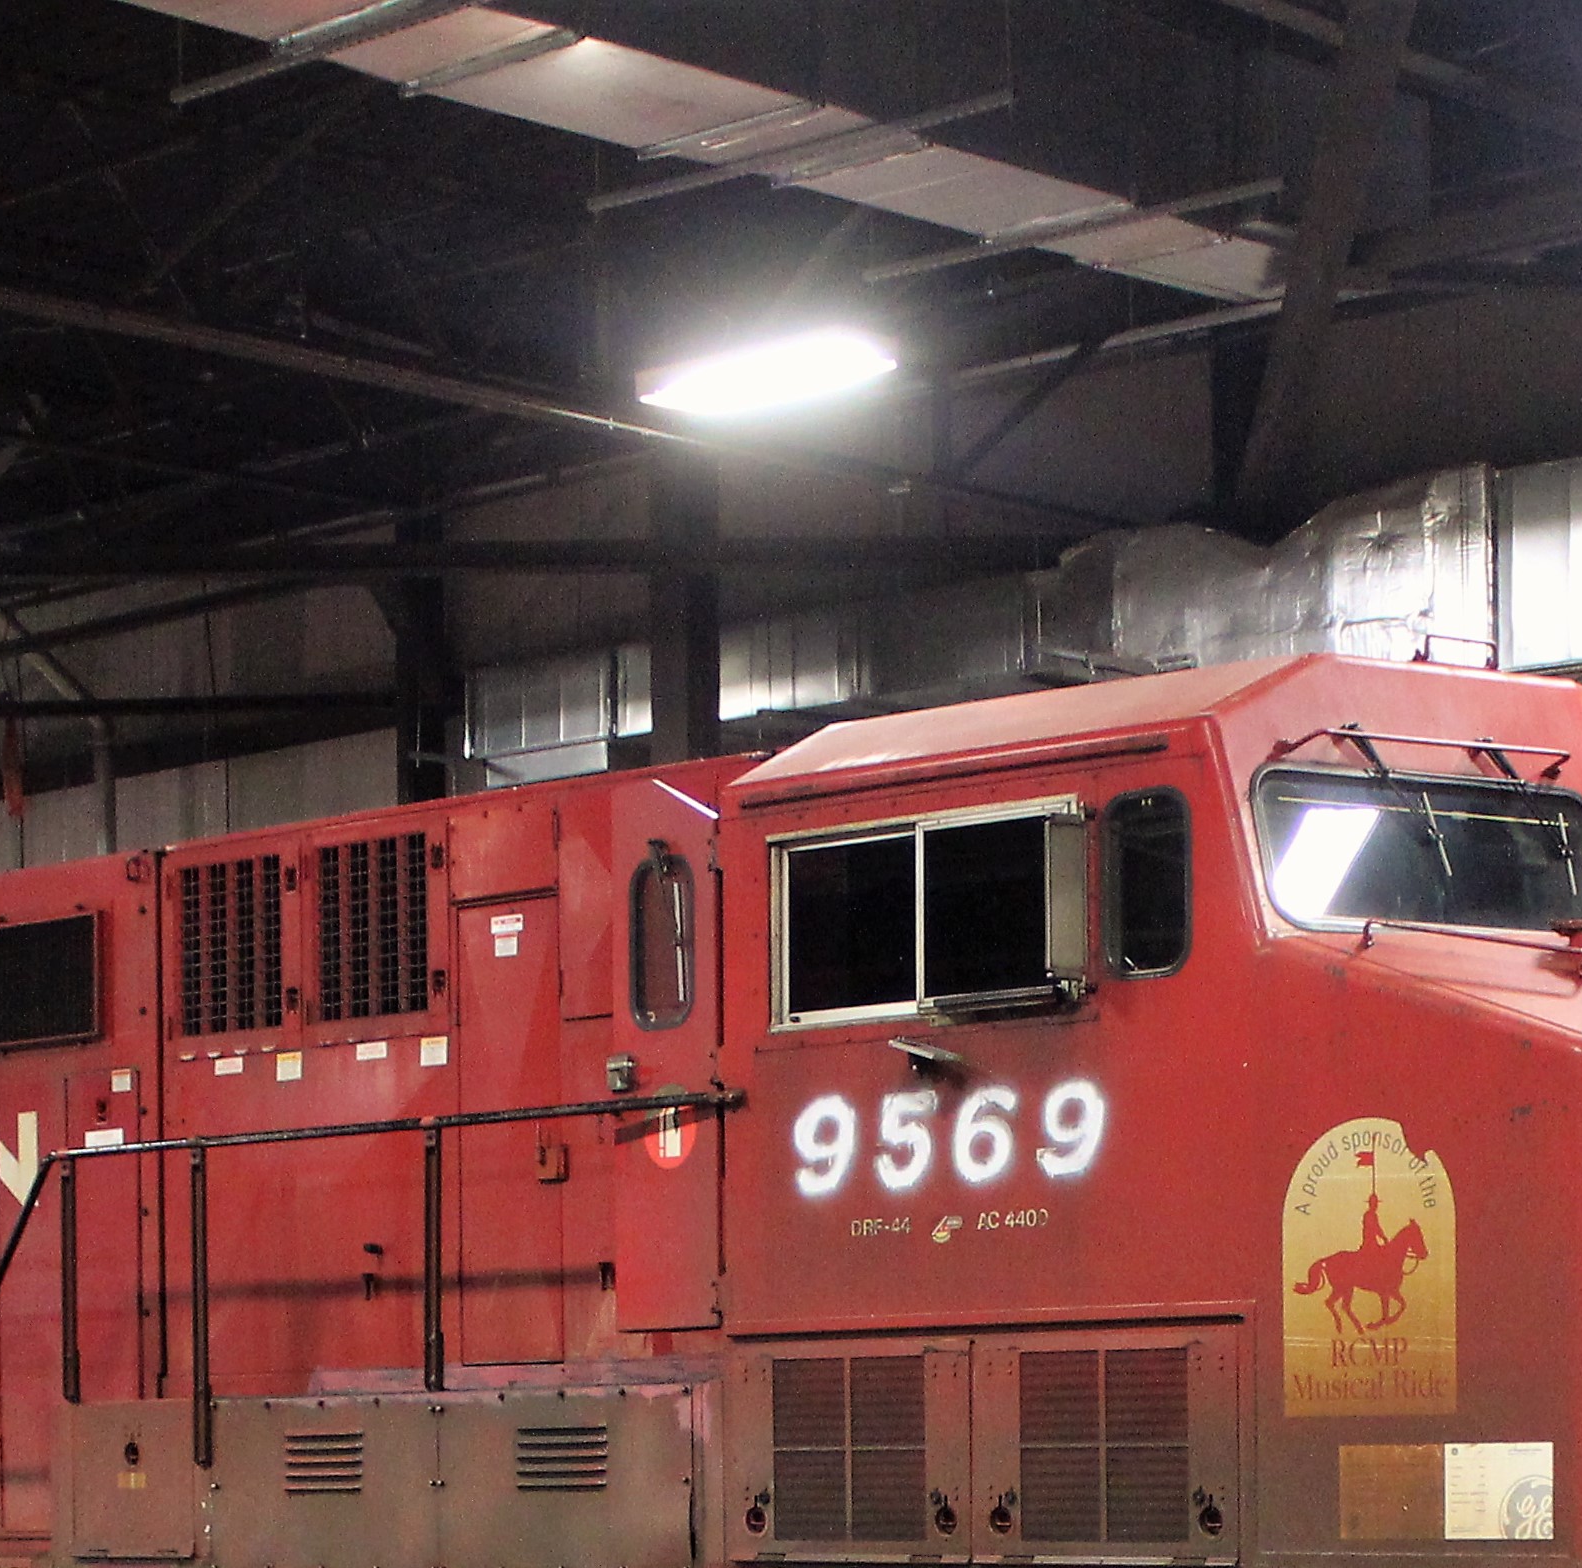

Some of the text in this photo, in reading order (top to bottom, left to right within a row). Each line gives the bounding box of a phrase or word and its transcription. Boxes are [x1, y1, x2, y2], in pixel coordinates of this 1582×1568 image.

[794, 1079, 1106, 1196] 9569
[1342, 1130, 1410, 1159] sponsor
[1301, 1141, 1339, 1198] proud
[1419, 1175, 1437, 1209] the
[977, 1211, 1000, 1231] AC
[1004, 1208, 1049, 1228] 4400
[1294, 1202, 1311, 1216] A
[1330, 1337, 1409, 1368] RCMP
[1293, 1368, 1448, 1400] Musical Ride
